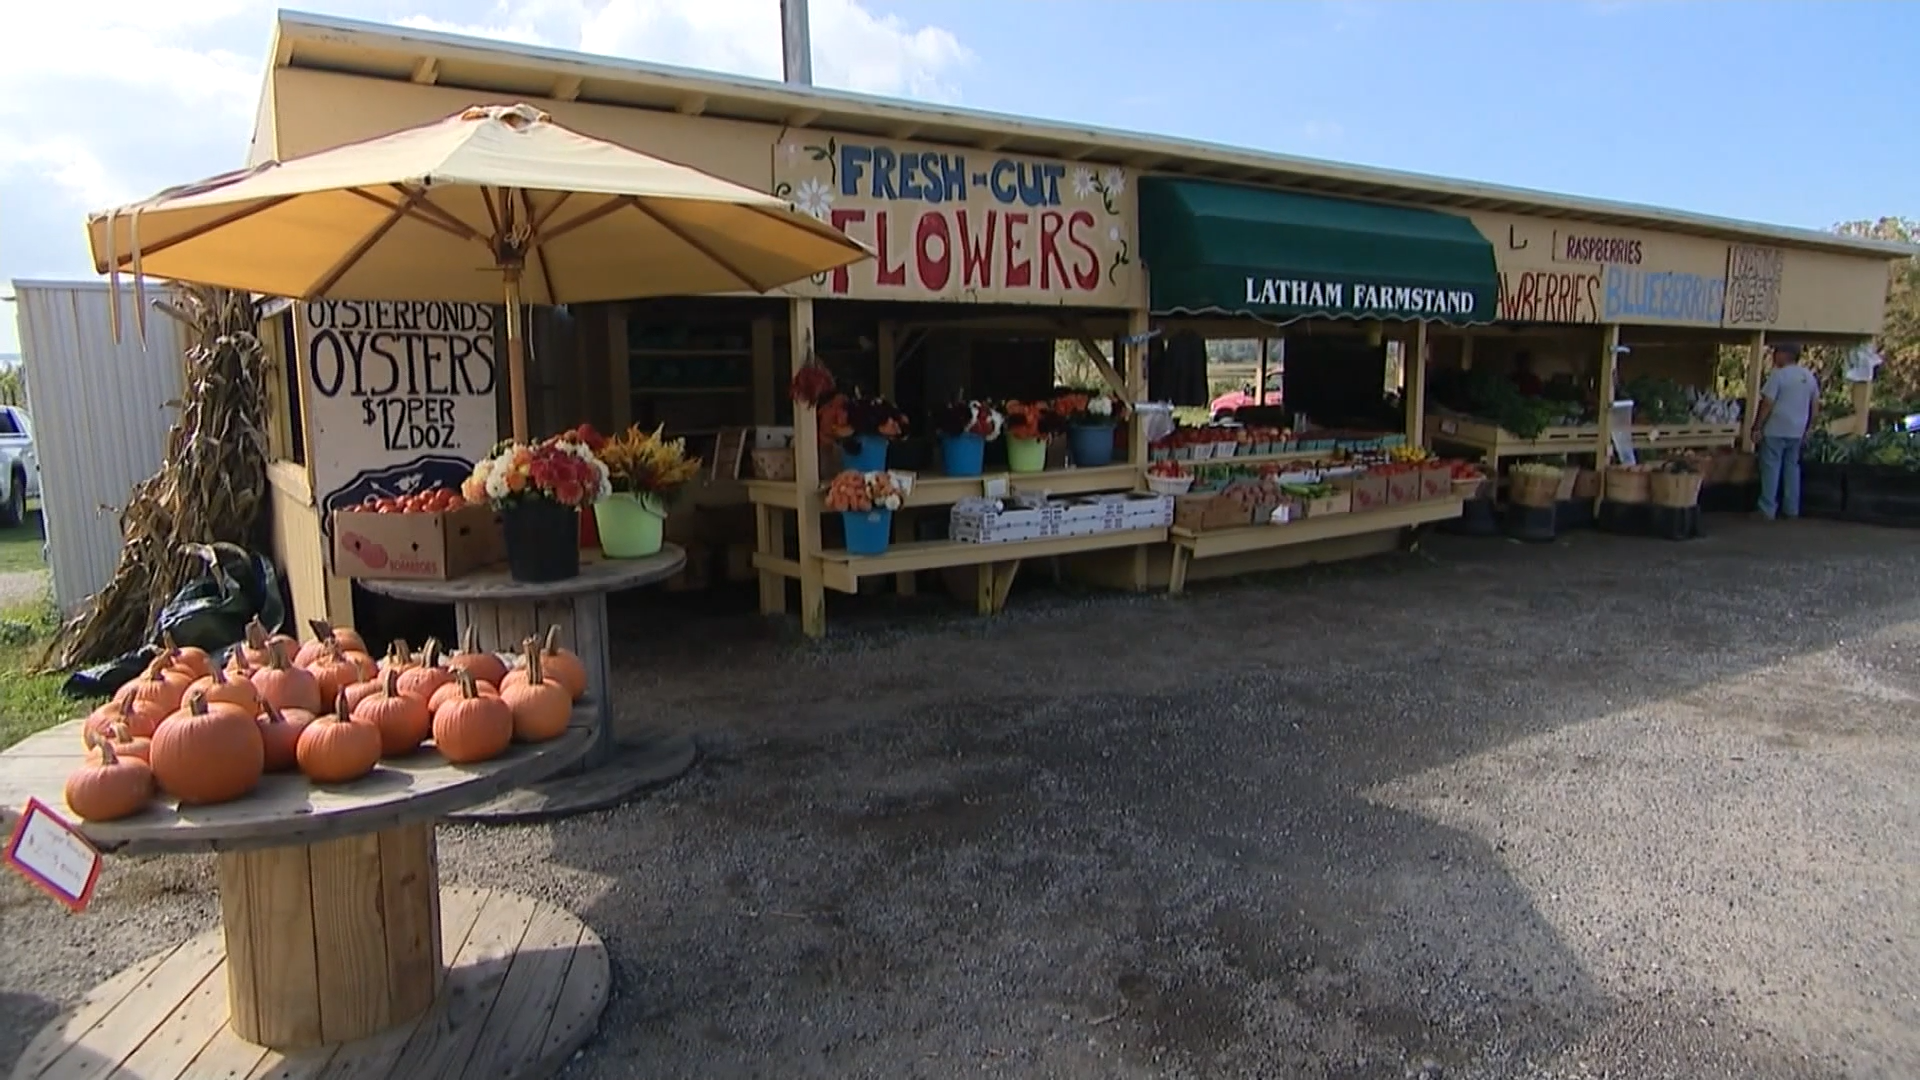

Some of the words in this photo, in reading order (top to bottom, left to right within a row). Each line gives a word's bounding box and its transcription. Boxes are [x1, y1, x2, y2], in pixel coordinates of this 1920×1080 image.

[840, 144, 1066, 207] FRESH-CUT
[832, 209, 1100, 294] FLOWERS
[1566, 234, 1642, 265] RASPBERRIES
[308, 301, 494, 332] OYSTERPONDS
[1245, 277, 1343, 308] LATHAM
[1353, 284, 1475, 313] FARMSTAND
[1605, 266, 1725, 324] BLUEBERRIES
[310, 329, 495, 397] OYSTERS
[362, 397, 408, 450] $12
[408, 399, 455, 424] PER
